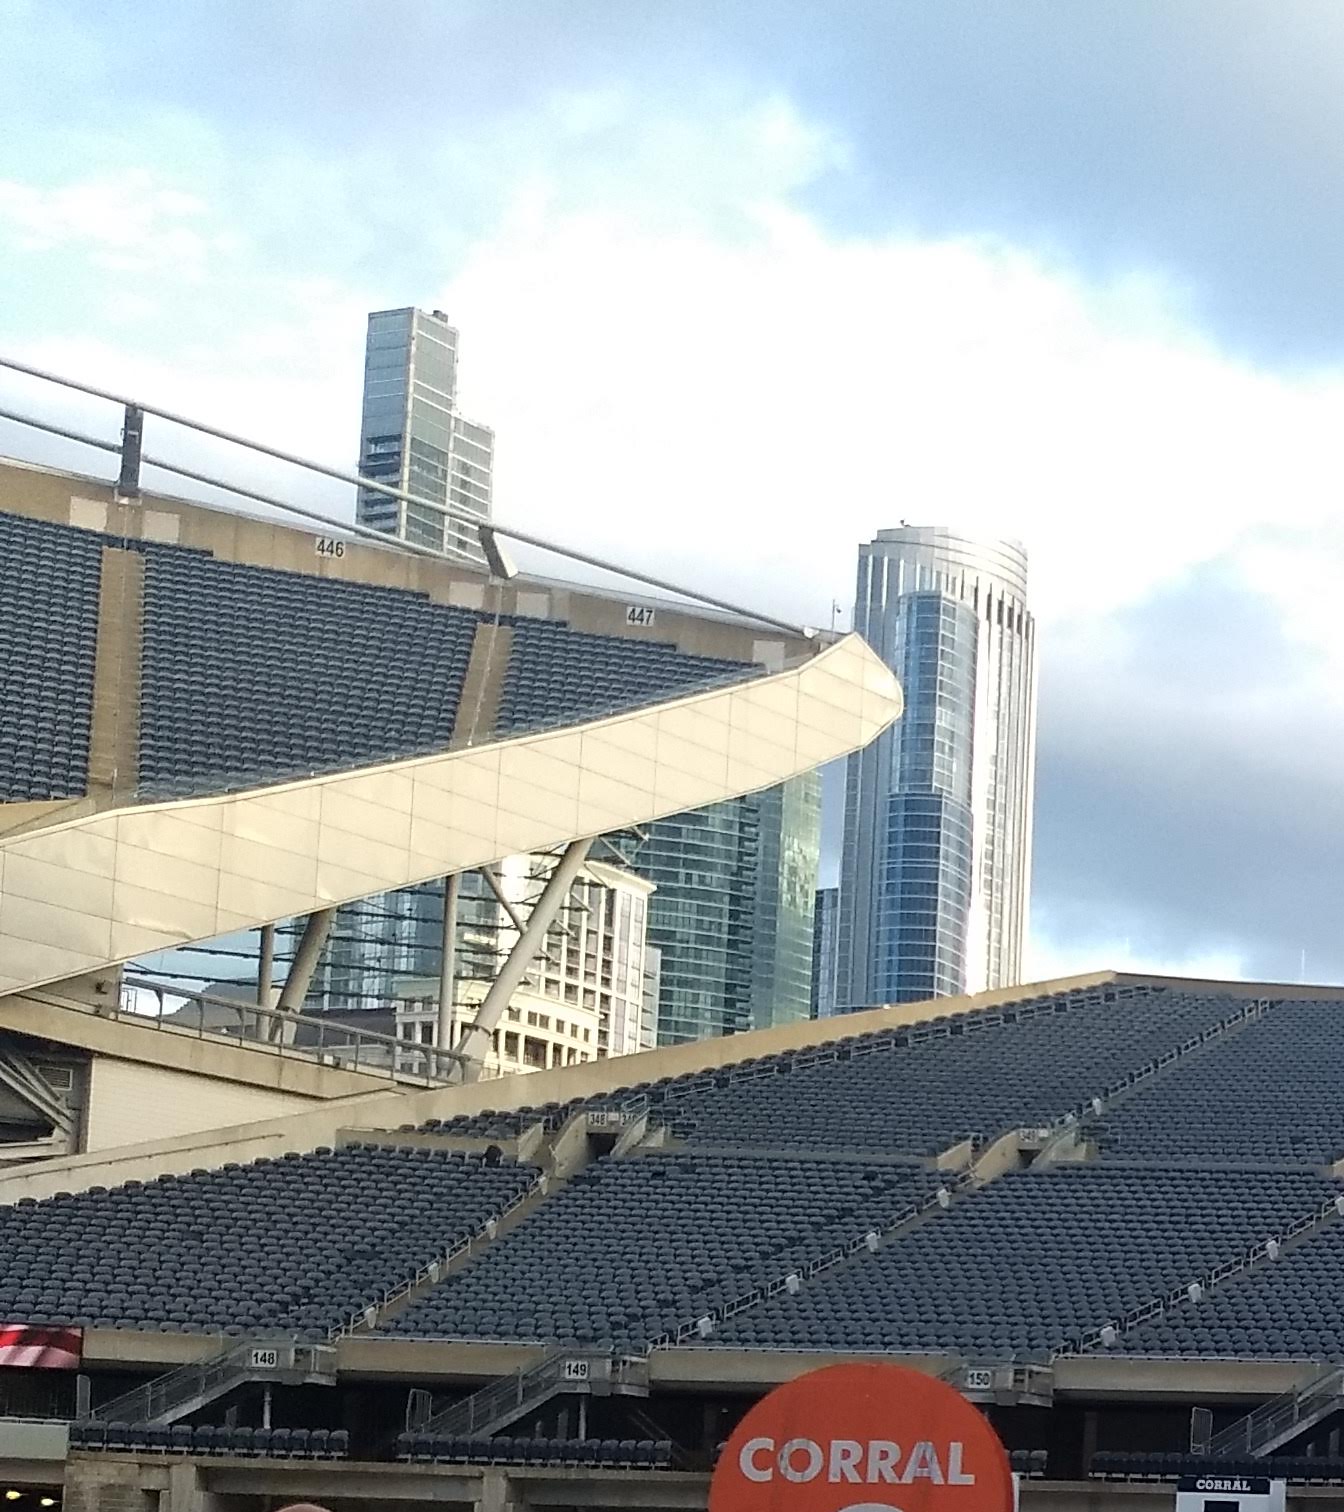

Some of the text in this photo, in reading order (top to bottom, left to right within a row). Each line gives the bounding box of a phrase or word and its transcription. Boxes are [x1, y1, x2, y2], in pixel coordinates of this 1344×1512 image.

[317, 539, 344, 557] 446
[628, 608, 653, 624] 447
[253, 1352, 275, 1365] 148
[567, 1363, 587, 1376] 149
[970, 1372, 990, 1386] 150
[738, 1437, 975, 1486] CORRAL
[1195, 1479, 1251, 1491] CORRAL
